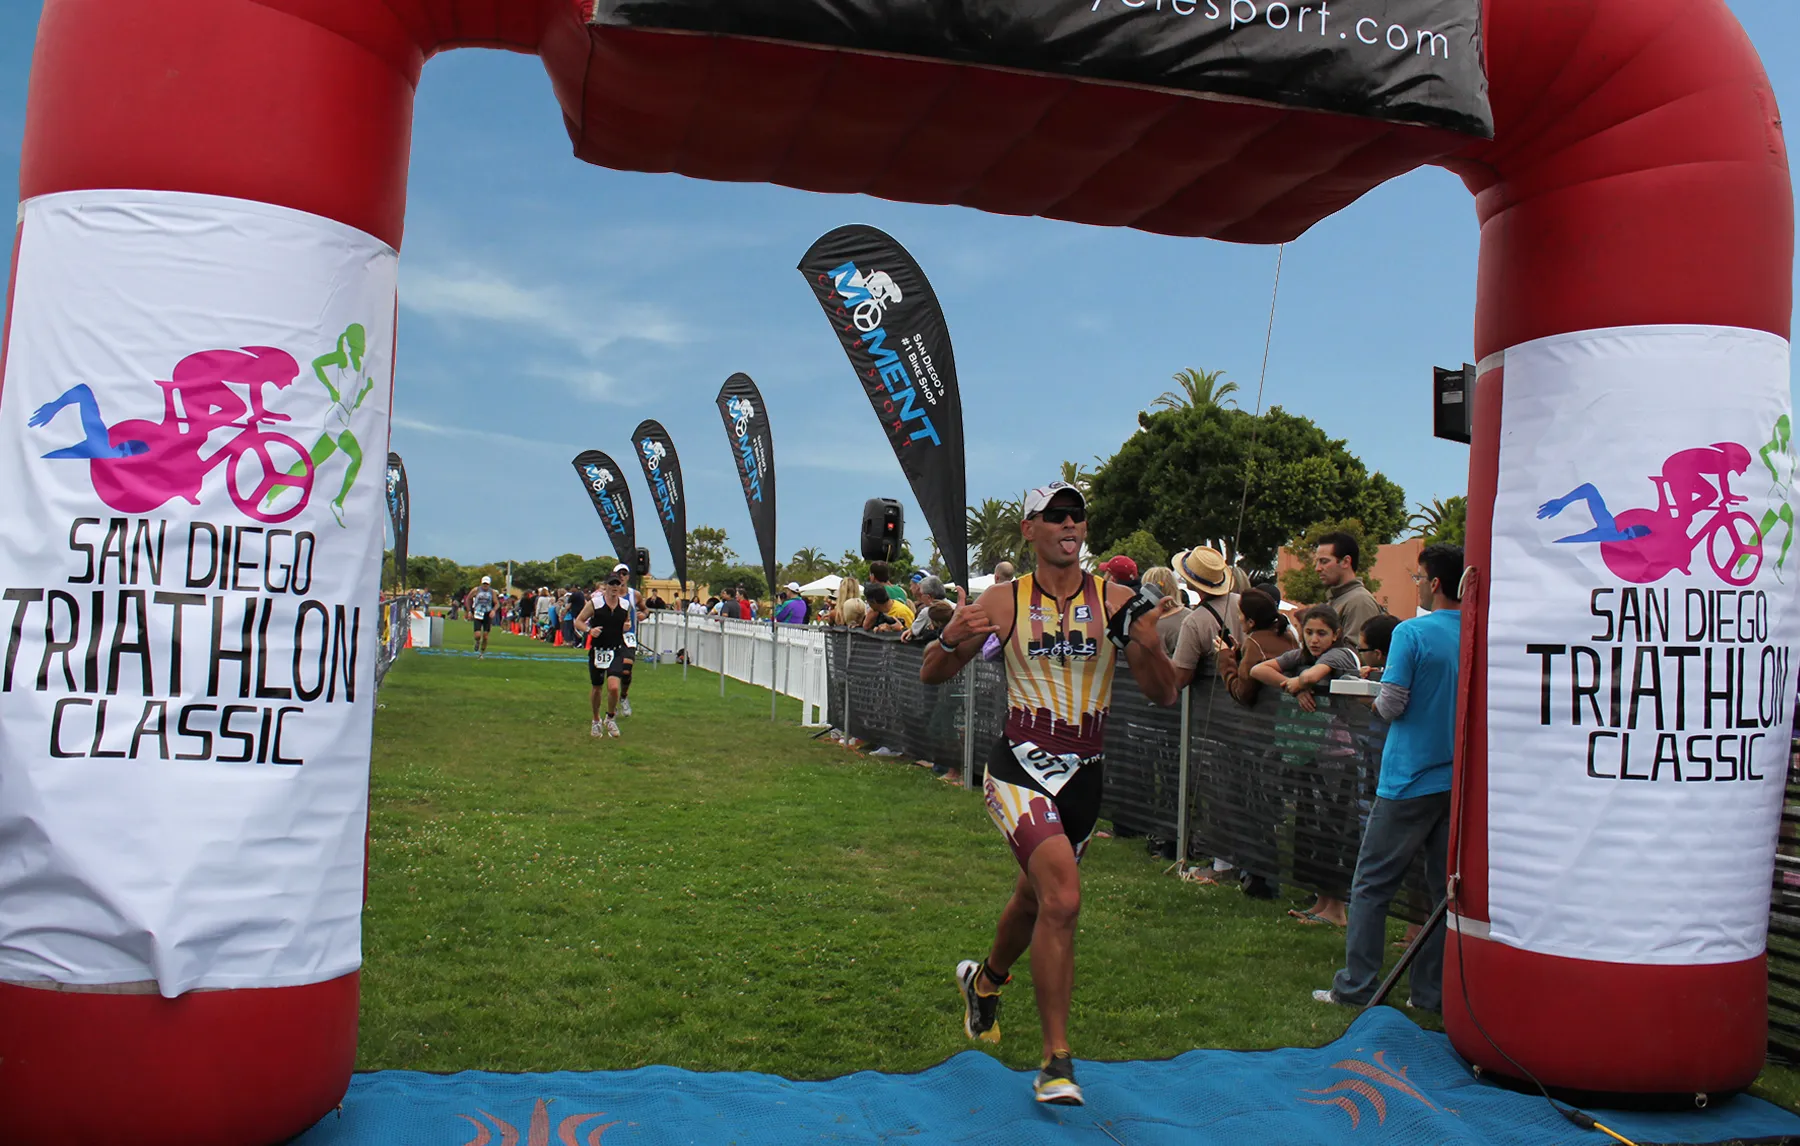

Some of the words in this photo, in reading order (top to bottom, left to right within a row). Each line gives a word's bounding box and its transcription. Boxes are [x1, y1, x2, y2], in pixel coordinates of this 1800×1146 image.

[827, 261, 942, 446] MOMENT
[901, 337, 913, 351] #1
[908, 352, 923, 378] BIKE
[919, 377, 937, 405] SHOP
[913, 333, 926, 356] SAN
[922, 355, 945, 397] DIEGO'S
[726, 394, 762, 502] MOMENT
[68, 517, 166, 586] SAN
[186, 521, 315, 595] DIEGO
[2, 588, 360, 703] TRIATHLON
[1591, 587, 1669, 642] SAN
[1685, 588, 1767, 643] DIEGO
[597, 653, 612, 662] 613
[1527, 644, 1789, 731] TRIATHLON
[50, 697, 304, 765] CLASSIC
[1587, 731, 1765, 782] CLASSIC
